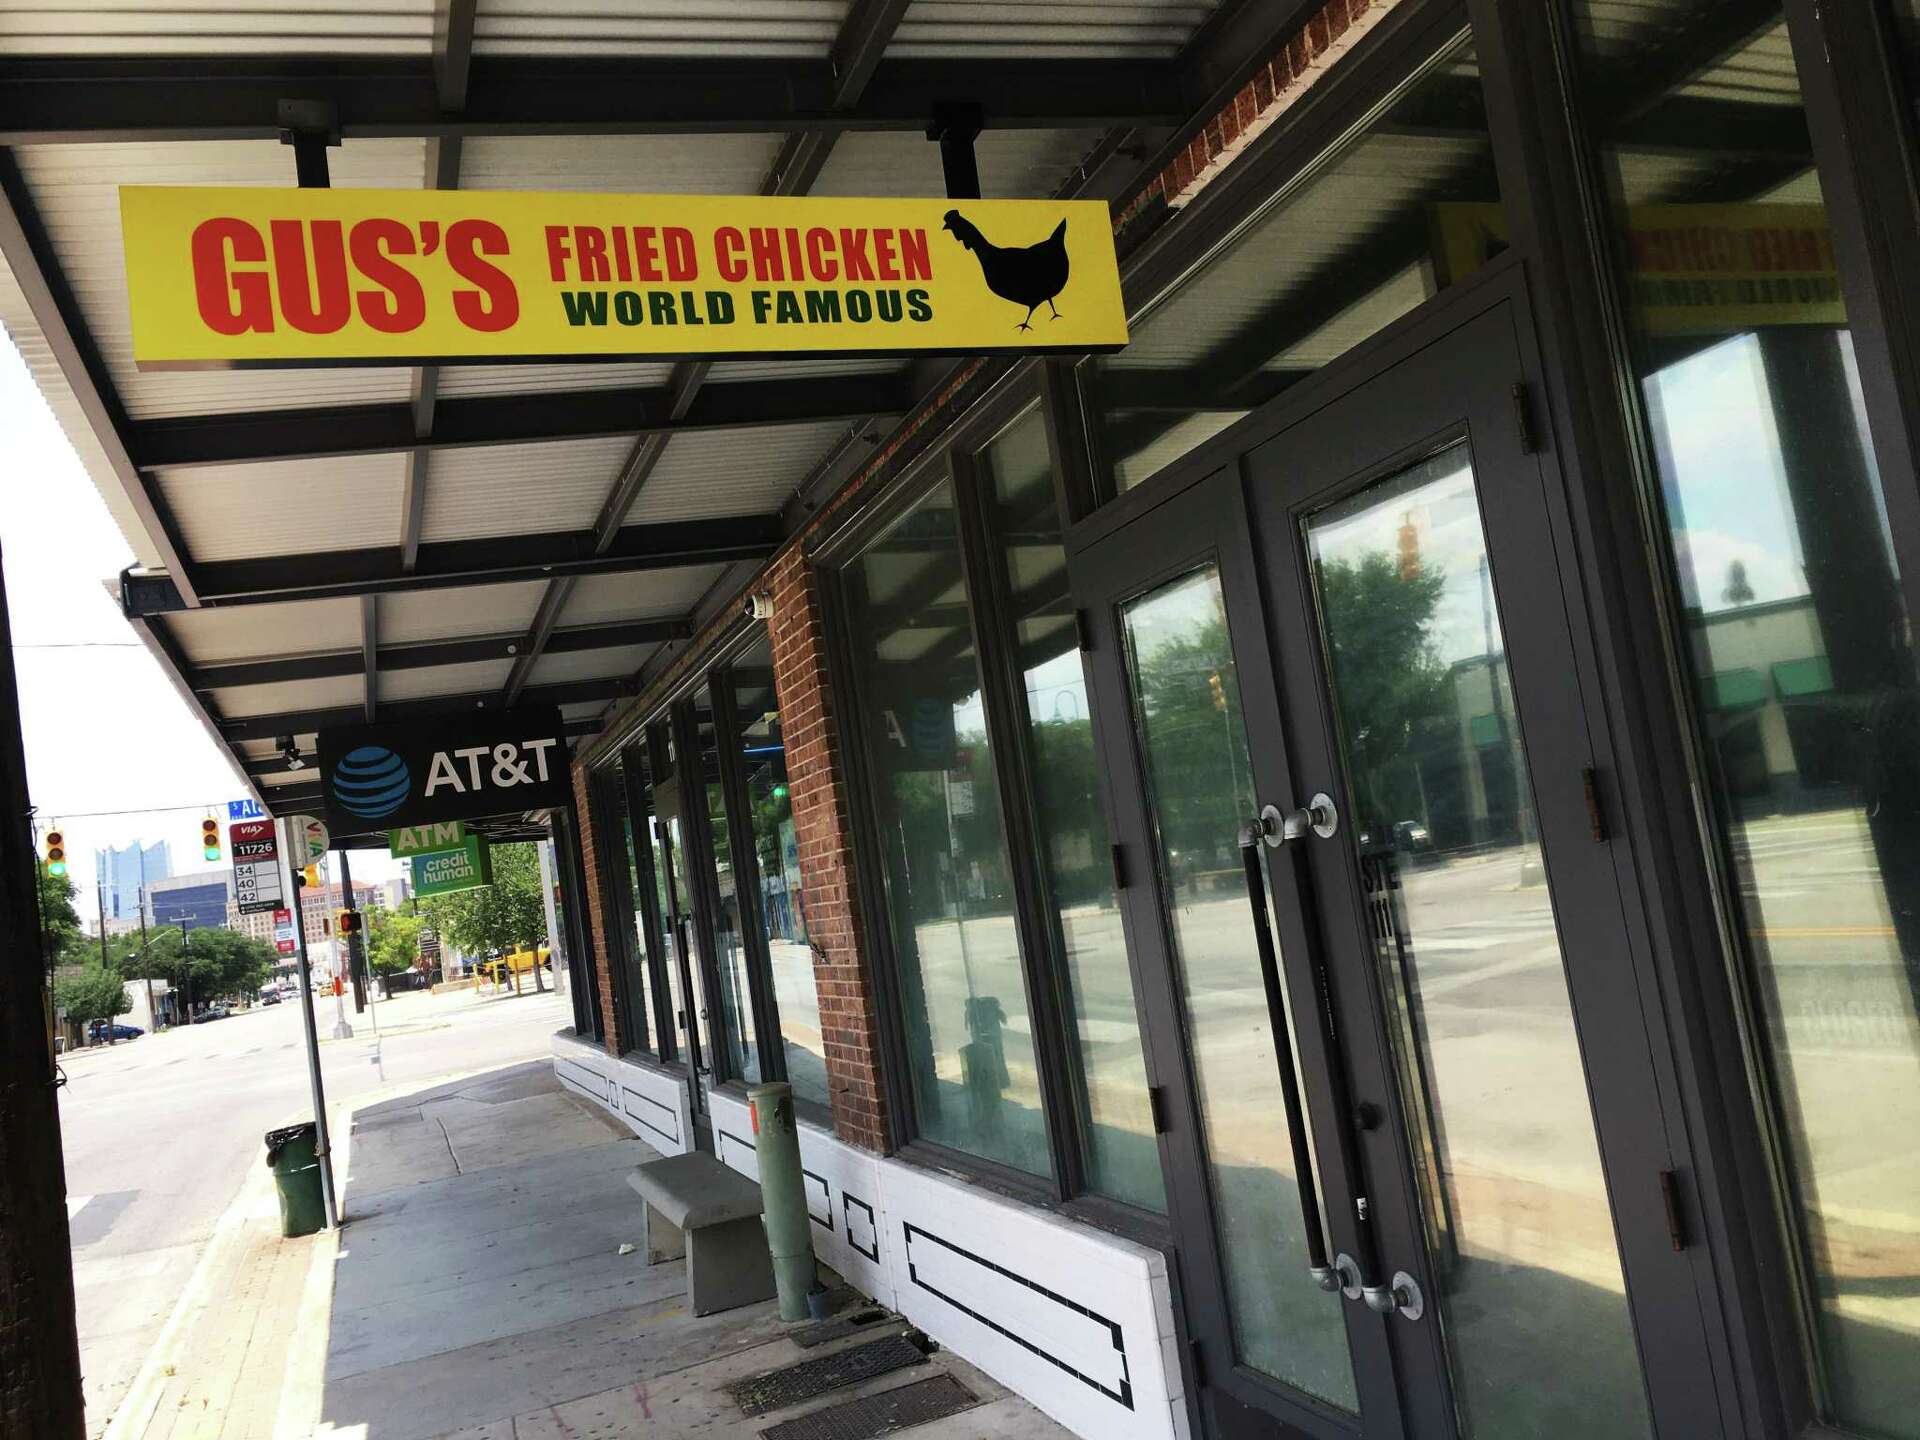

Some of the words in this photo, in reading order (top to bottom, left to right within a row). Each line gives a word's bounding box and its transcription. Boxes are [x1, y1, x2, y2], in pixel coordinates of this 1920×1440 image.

[545, 225, 698, 282] FRIED
[713, 226, 932, 281] CHICKEN
[191, 217, 519, 336] GUS'S
[561, 290, 735, 326] WORLD
[752, 289, 933, 324] FAMOUS
[424, 738, 557, 797] AT&T
[241, 825, 258, 834] VIA
[397, 821, 460, 851] ATM
[240, 843, 273, 855] 11726
[426, 851, 469, 871] credit
[237, 866, 253, 876] 34
[423, 865, 474, 884] human
[239, 879, 254, 888] 40
[241, 893, 256, 901] 42
